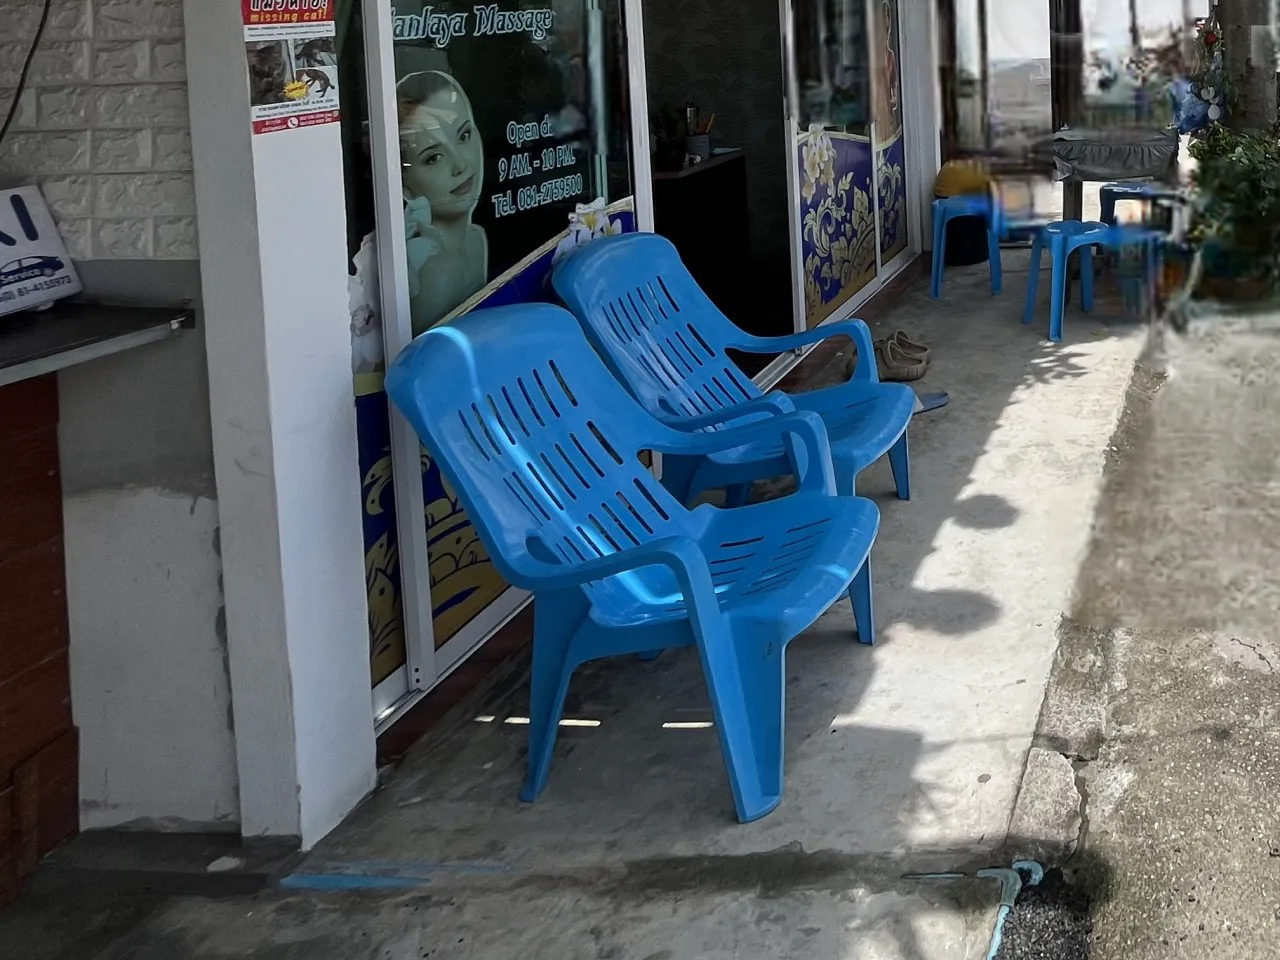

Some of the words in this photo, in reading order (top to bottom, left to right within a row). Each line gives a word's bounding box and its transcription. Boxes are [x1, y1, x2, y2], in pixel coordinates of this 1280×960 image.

[250, 11, 298, 23] missing
[303, 7, 327, 20] cat!
[391, 5, 468, 48] anlaya
[473, 2, 553, 41] Massage
[507, 120, 540, 148] Open
[498, 157, 508, 183] 9
[509, 152, 533, 180] AM.
[541, 147, 556, 171] 10
[556, 144, 576, 168] PM.
[491, 189, 517, 219] Tel.
[517, 172, 583, 211] 081-2759500
